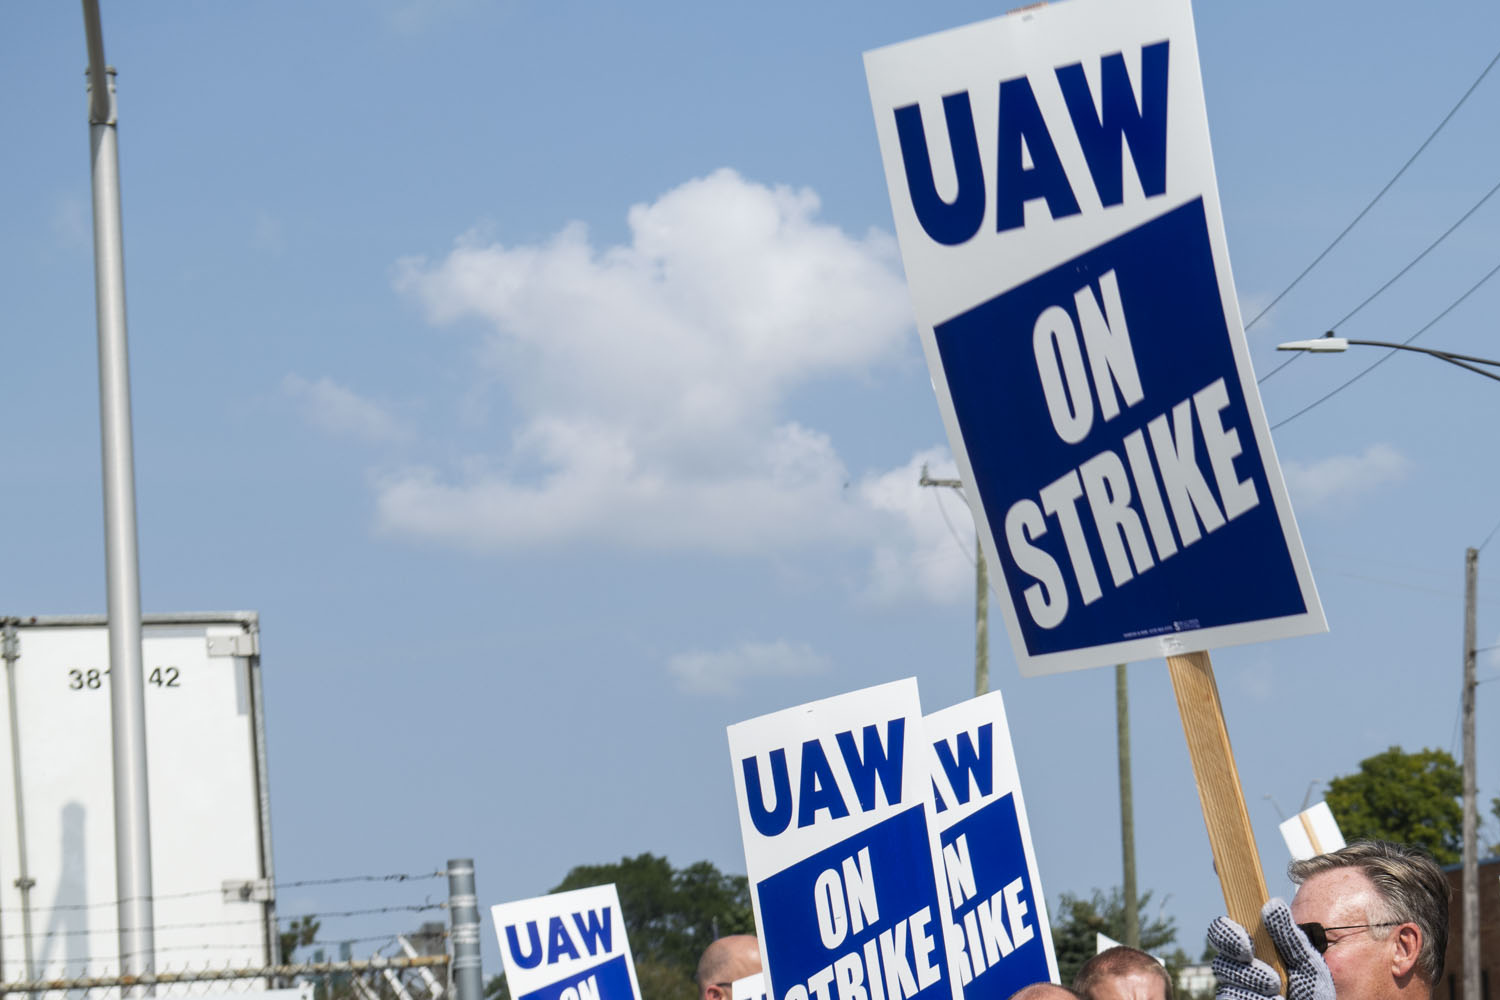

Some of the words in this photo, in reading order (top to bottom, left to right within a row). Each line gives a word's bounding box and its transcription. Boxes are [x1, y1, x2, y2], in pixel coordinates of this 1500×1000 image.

[894, 39, 1170, 246] UAW
[1032, 268, 1145, 444] ON
[1004, 376, 1259, 630] STRIKE
[742, 717, 905, 837] UAW
[813, 846, 879, 949] ON
[943, 833, 977, 910] N
[505, 906, 612, 970] UAW
